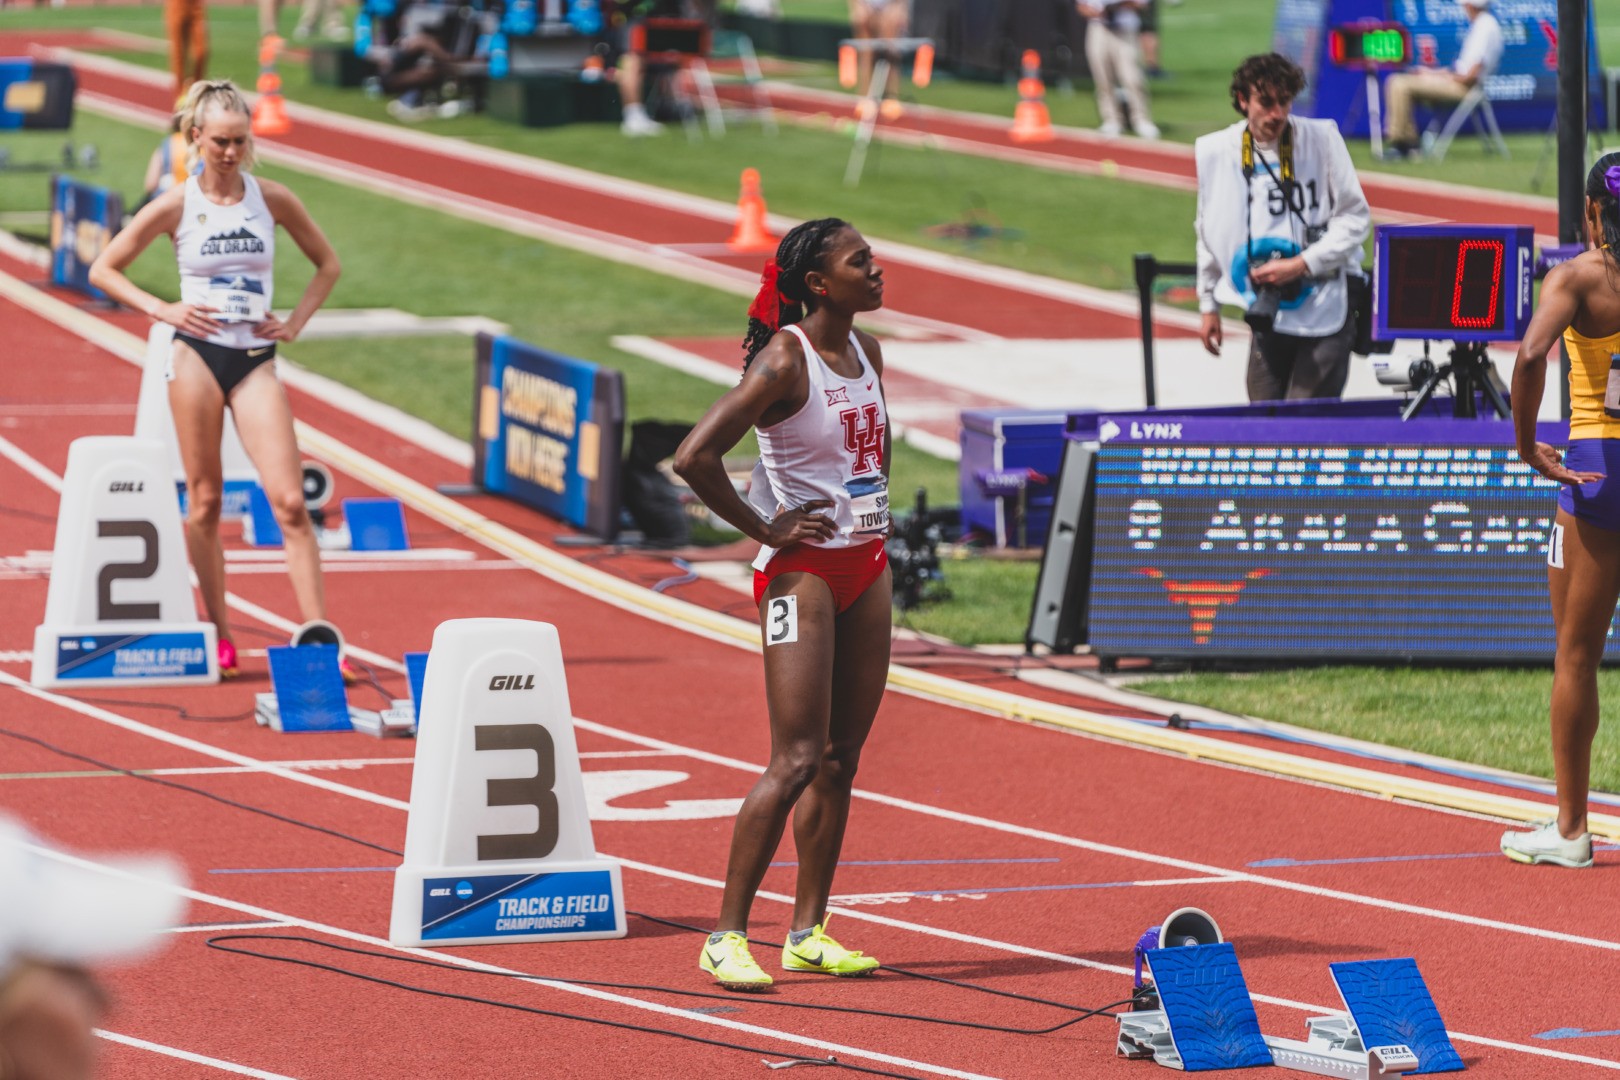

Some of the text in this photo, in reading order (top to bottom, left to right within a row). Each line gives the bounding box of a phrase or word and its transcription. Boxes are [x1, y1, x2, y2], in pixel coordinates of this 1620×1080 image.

[1268, 178, 1319, 215] 501
[200, 239, 265, 255] COLORADO
[1450, 239, 1503, 327] 0
[1130, 421, 1183, 440] LYNX
[109, 480, 144, 493] GILL
[97, 520, 160, 621] 2
[771, 598, 790, 641] 3
[114, 648, 156, 664] TRACK
[169, 647, 204, 664] FIELD
[489, 674, 535, 691] GILL
[474, 723, 560, 861] 3
[498, 894, 610, 917] TRACK & FIELD
[495, 914, 587, 932] CHAMPIONSHIPS
[1380, 1046, 1409, 1056] GILL
